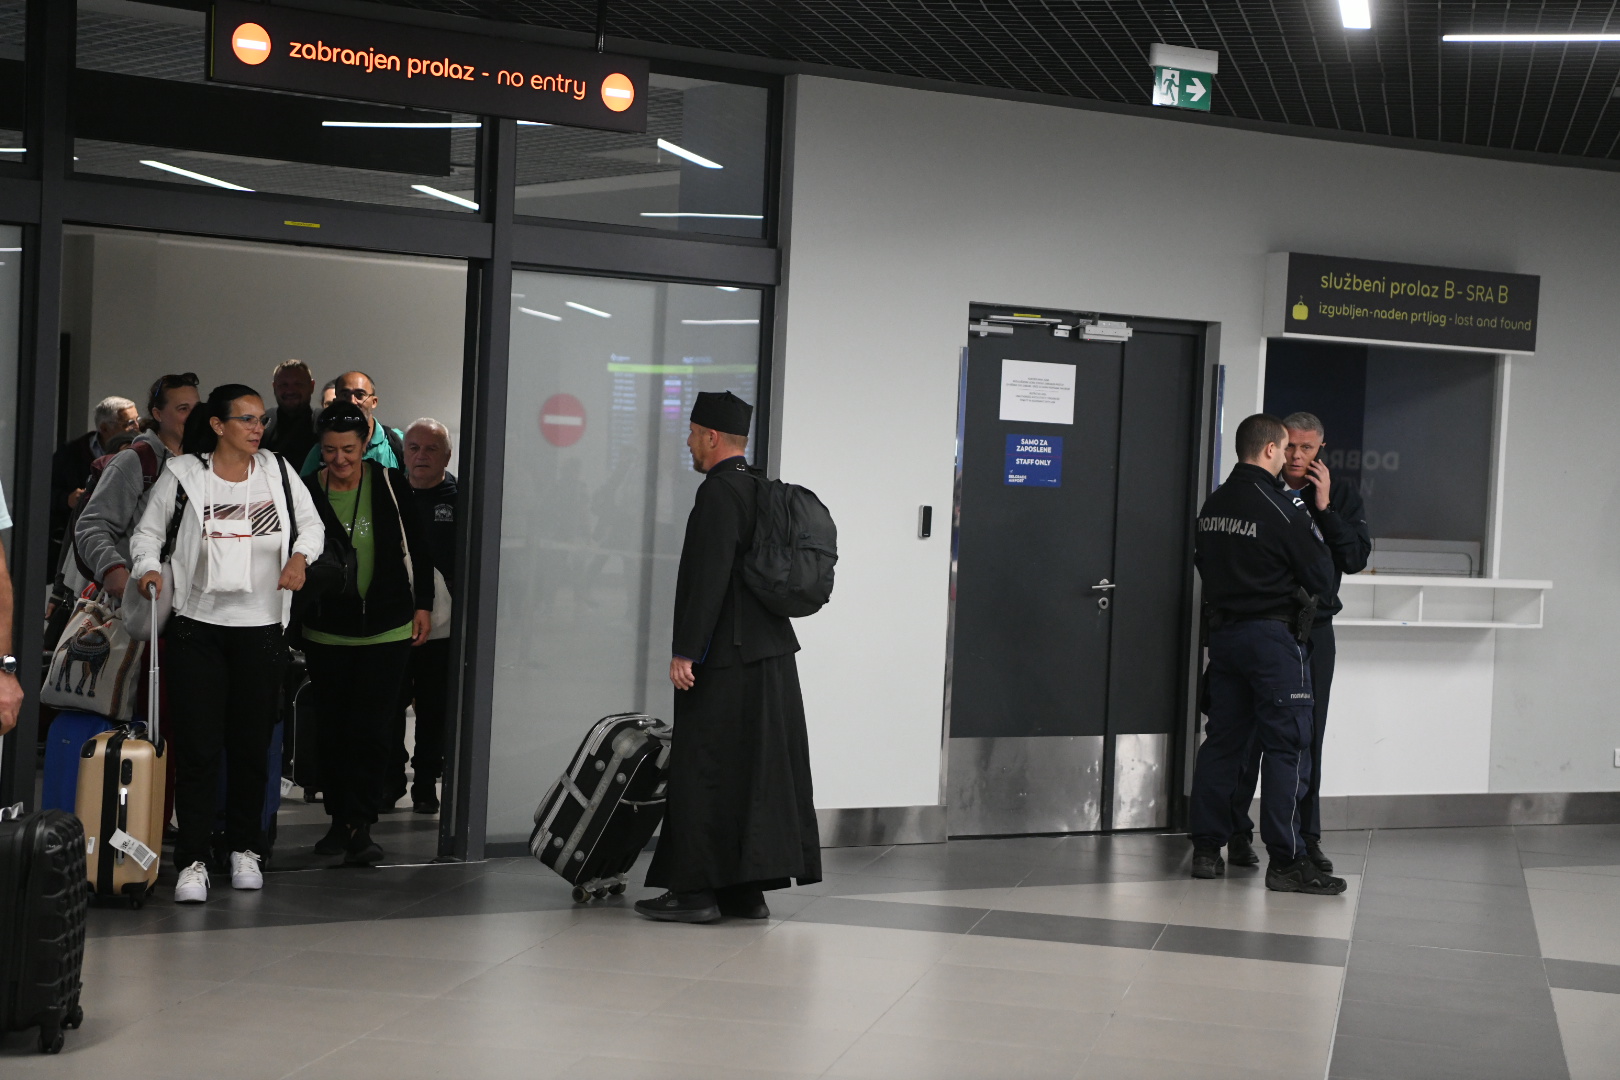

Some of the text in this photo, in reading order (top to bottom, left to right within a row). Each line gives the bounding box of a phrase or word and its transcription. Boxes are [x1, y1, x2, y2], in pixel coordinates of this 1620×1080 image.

[290, 41, 400, 73] zabranjen
[407, 57, 475, 81] prolaz
[497, 70, 524, 87] no
[530, 74, 587, 100] entry
[1320, 272, 1386, 294] službeni
[1390, 280, 1439, 299] prolaz
[1466, 284, 1494, 303] SRA
[1498, 285, 1509, 304] B
[1410, 310, 1447, 328] prtljag
[1454, 312, 1474, 328] lost
[1476, 315, 1498, 329] and
[1500, 316, 1532, 332] found
[1016, 445, 1052, 453] ZAPOSLENE
[1020, 438, 1039, 446] SAMO
[1198, 517, 1257, 538] ПОЛИЦИЈА
